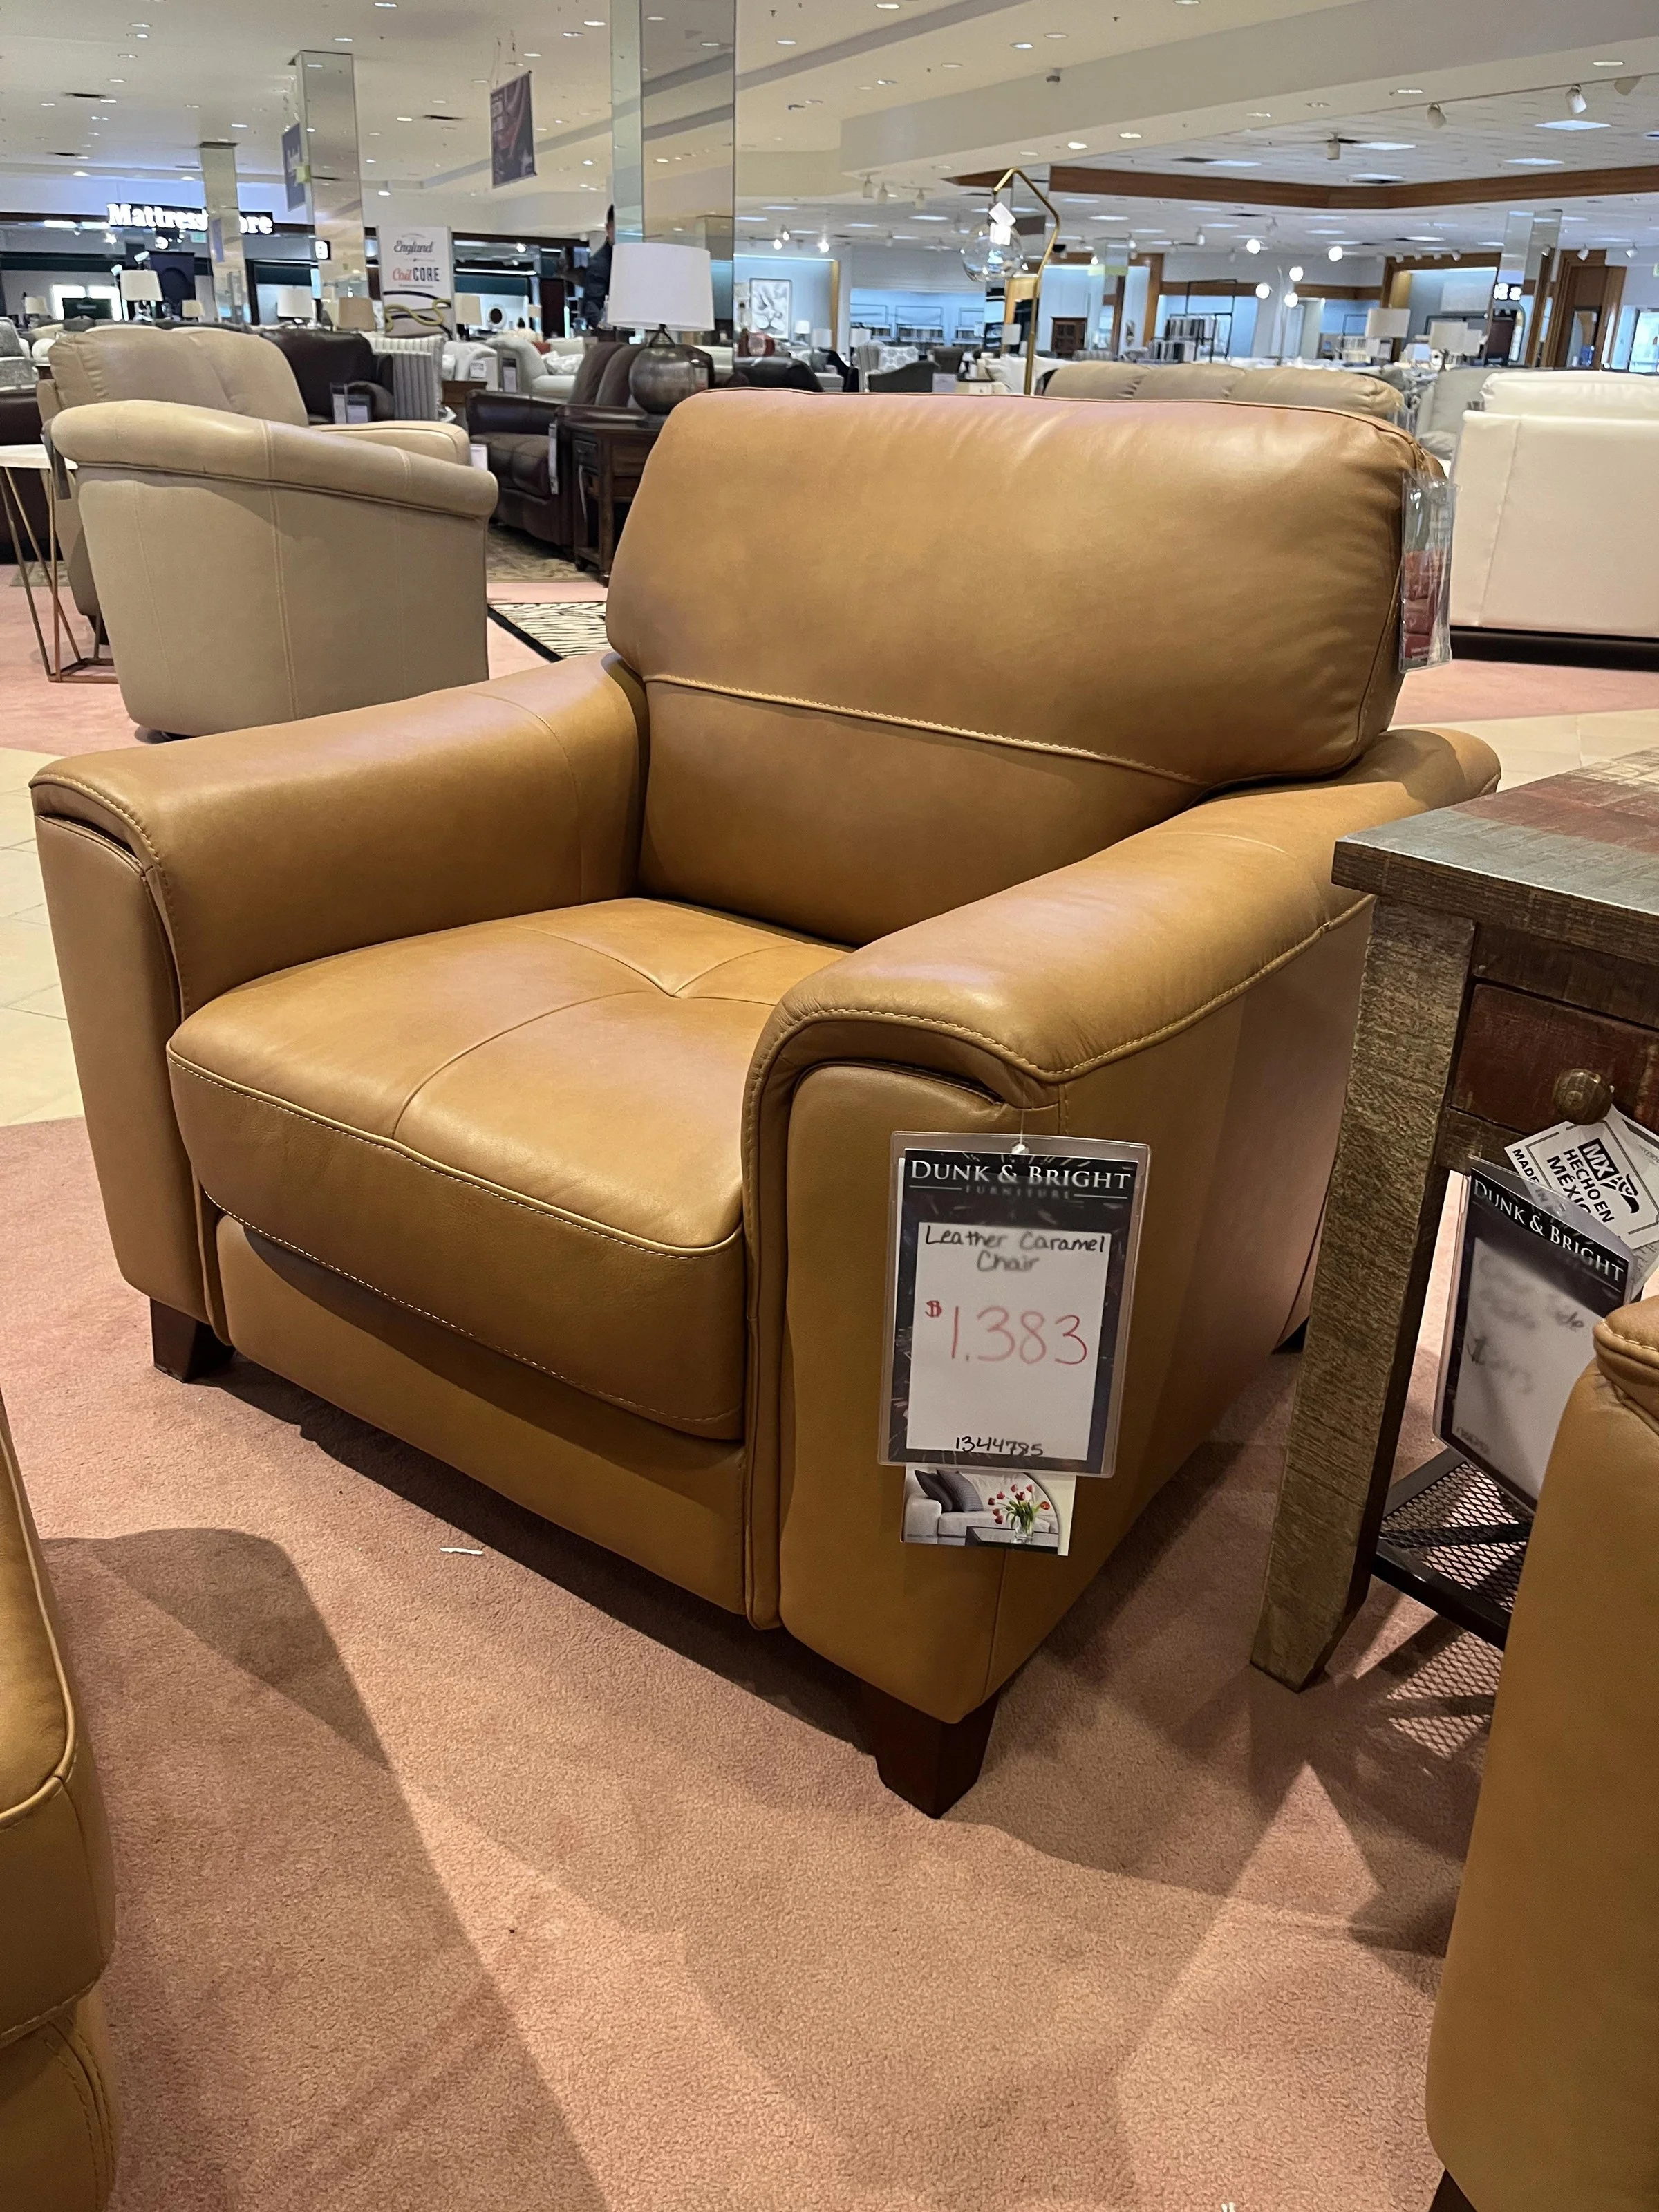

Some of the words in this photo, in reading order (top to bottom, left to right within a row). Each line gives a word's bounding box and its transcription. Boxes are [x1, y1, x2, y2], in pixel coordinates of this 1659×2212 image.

[106, 203, 208, 231] Mattress
[239, 216, 273, 234] ore
[393, 240, 433, 255] England
[910, 1160, 990, 1182] DUNK
[997, 1164, 1018, 1184] &
[1029, 1166, 1132, 1189] BRIGHT
[1582, 1143, 1615, 1179] MX
[1546, 1155, 1591, 1214] MÉXI
[1563, 1148, 1601, 1201] HECHO
[1593, 1200, 1615, 1224] EN
[1529, 1215, 1545, 1237] &
[955, 1436, 1044, 1457] 1344785
